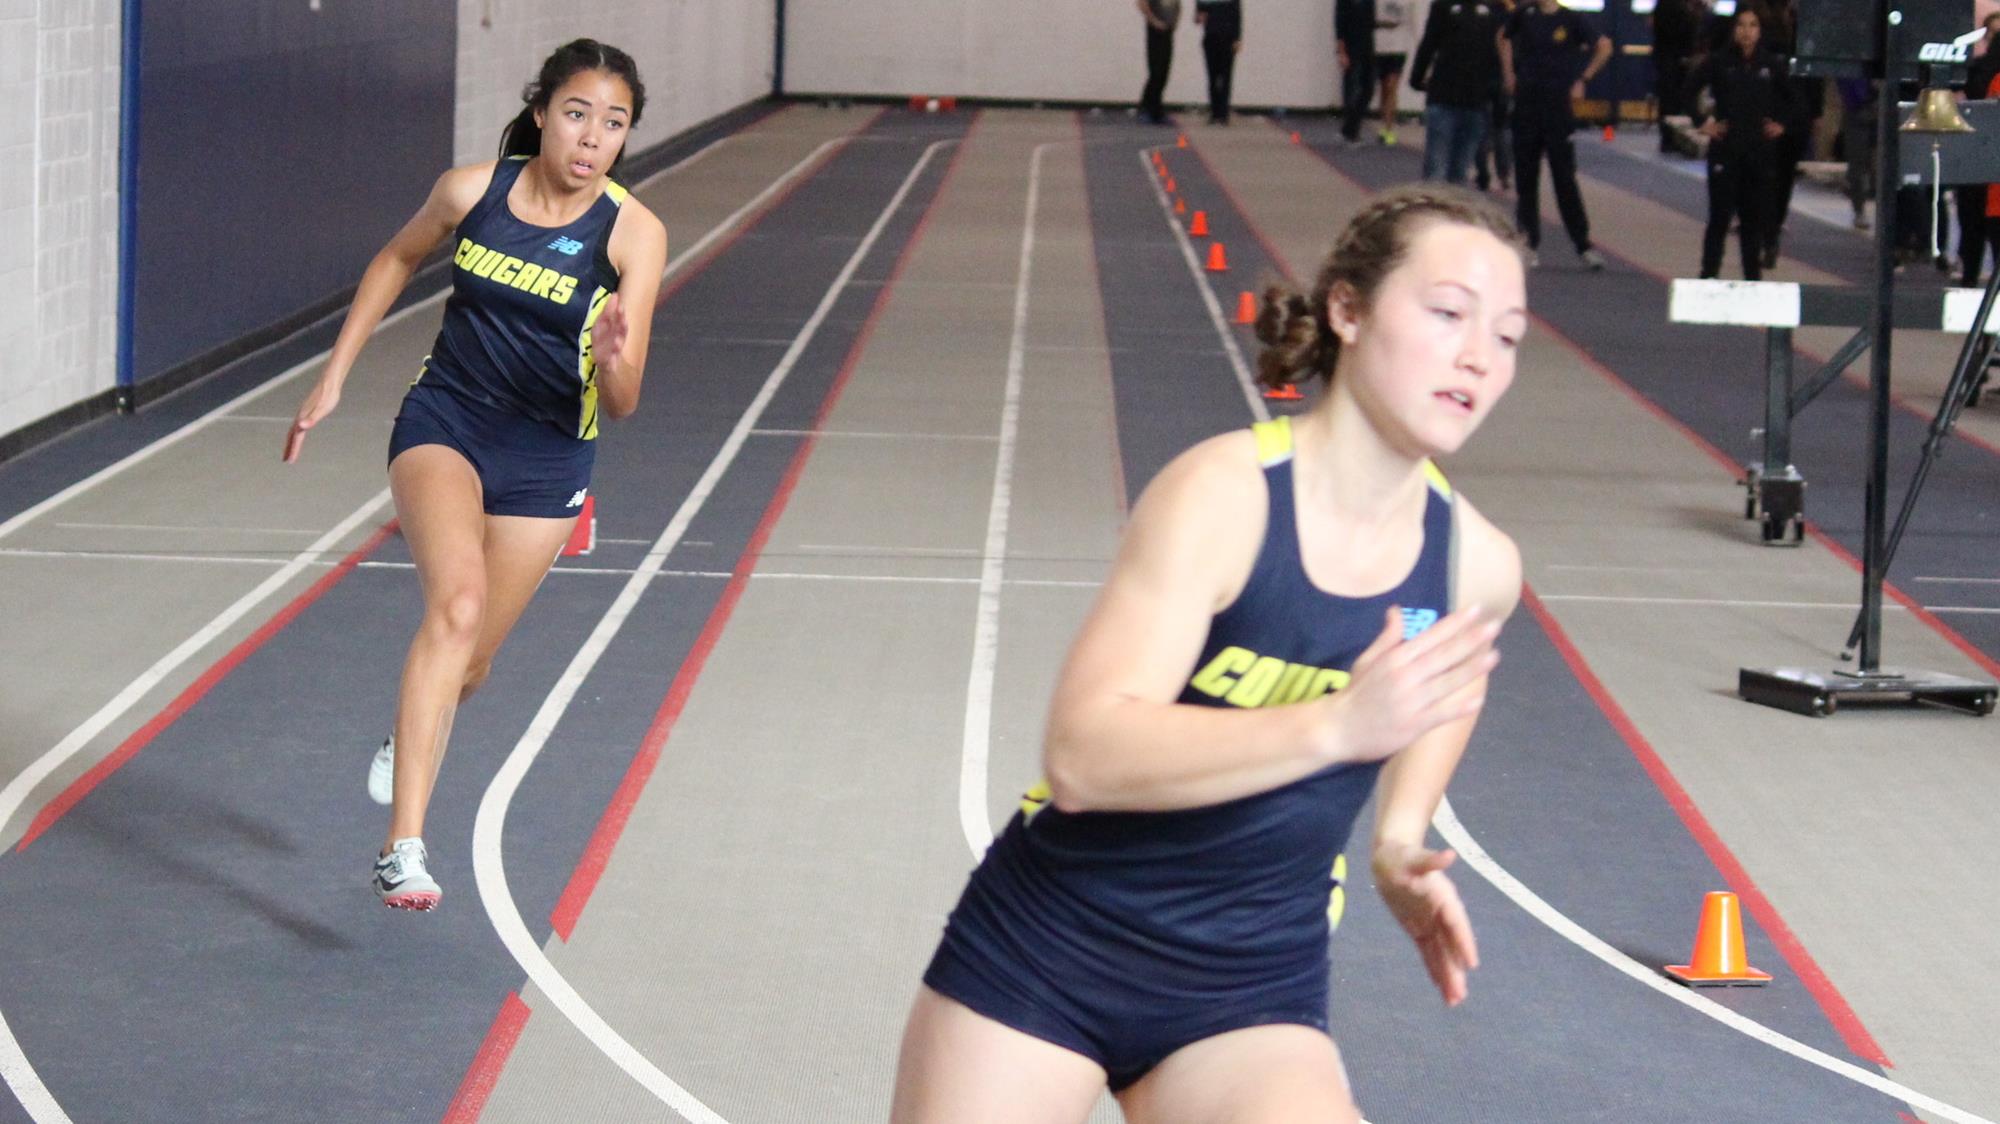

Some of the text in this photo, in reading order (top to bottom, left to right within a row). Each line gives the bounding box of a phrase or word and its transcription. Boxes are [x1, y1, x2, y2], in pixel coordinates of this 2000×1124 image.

[1918, 38, 1971, 62] GILL
[547, 236, 583, 255] NB
[454, 238, 578, 304] COUGARS
